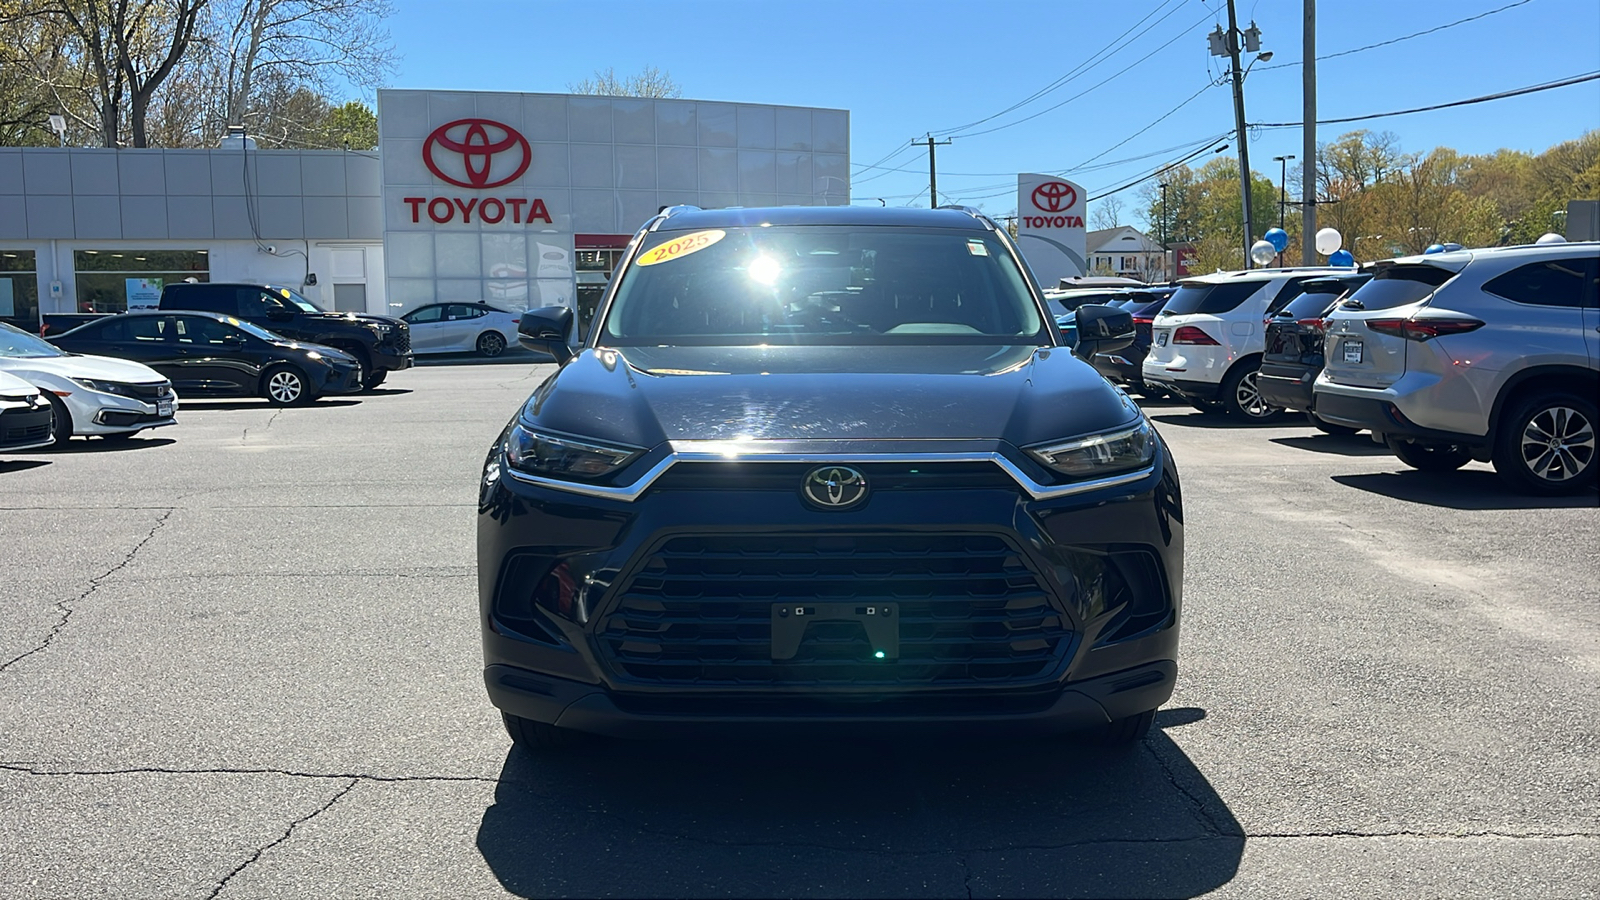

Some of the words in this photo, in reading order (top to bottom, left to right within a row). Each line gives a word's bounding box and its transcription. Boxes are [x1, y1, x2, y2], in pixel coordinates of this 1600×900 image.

[403, 197, 553, 224] TOYOTA
[1023, 215, 1084, 228] TOYOTA
[654, 233, 709, 261] 2025
